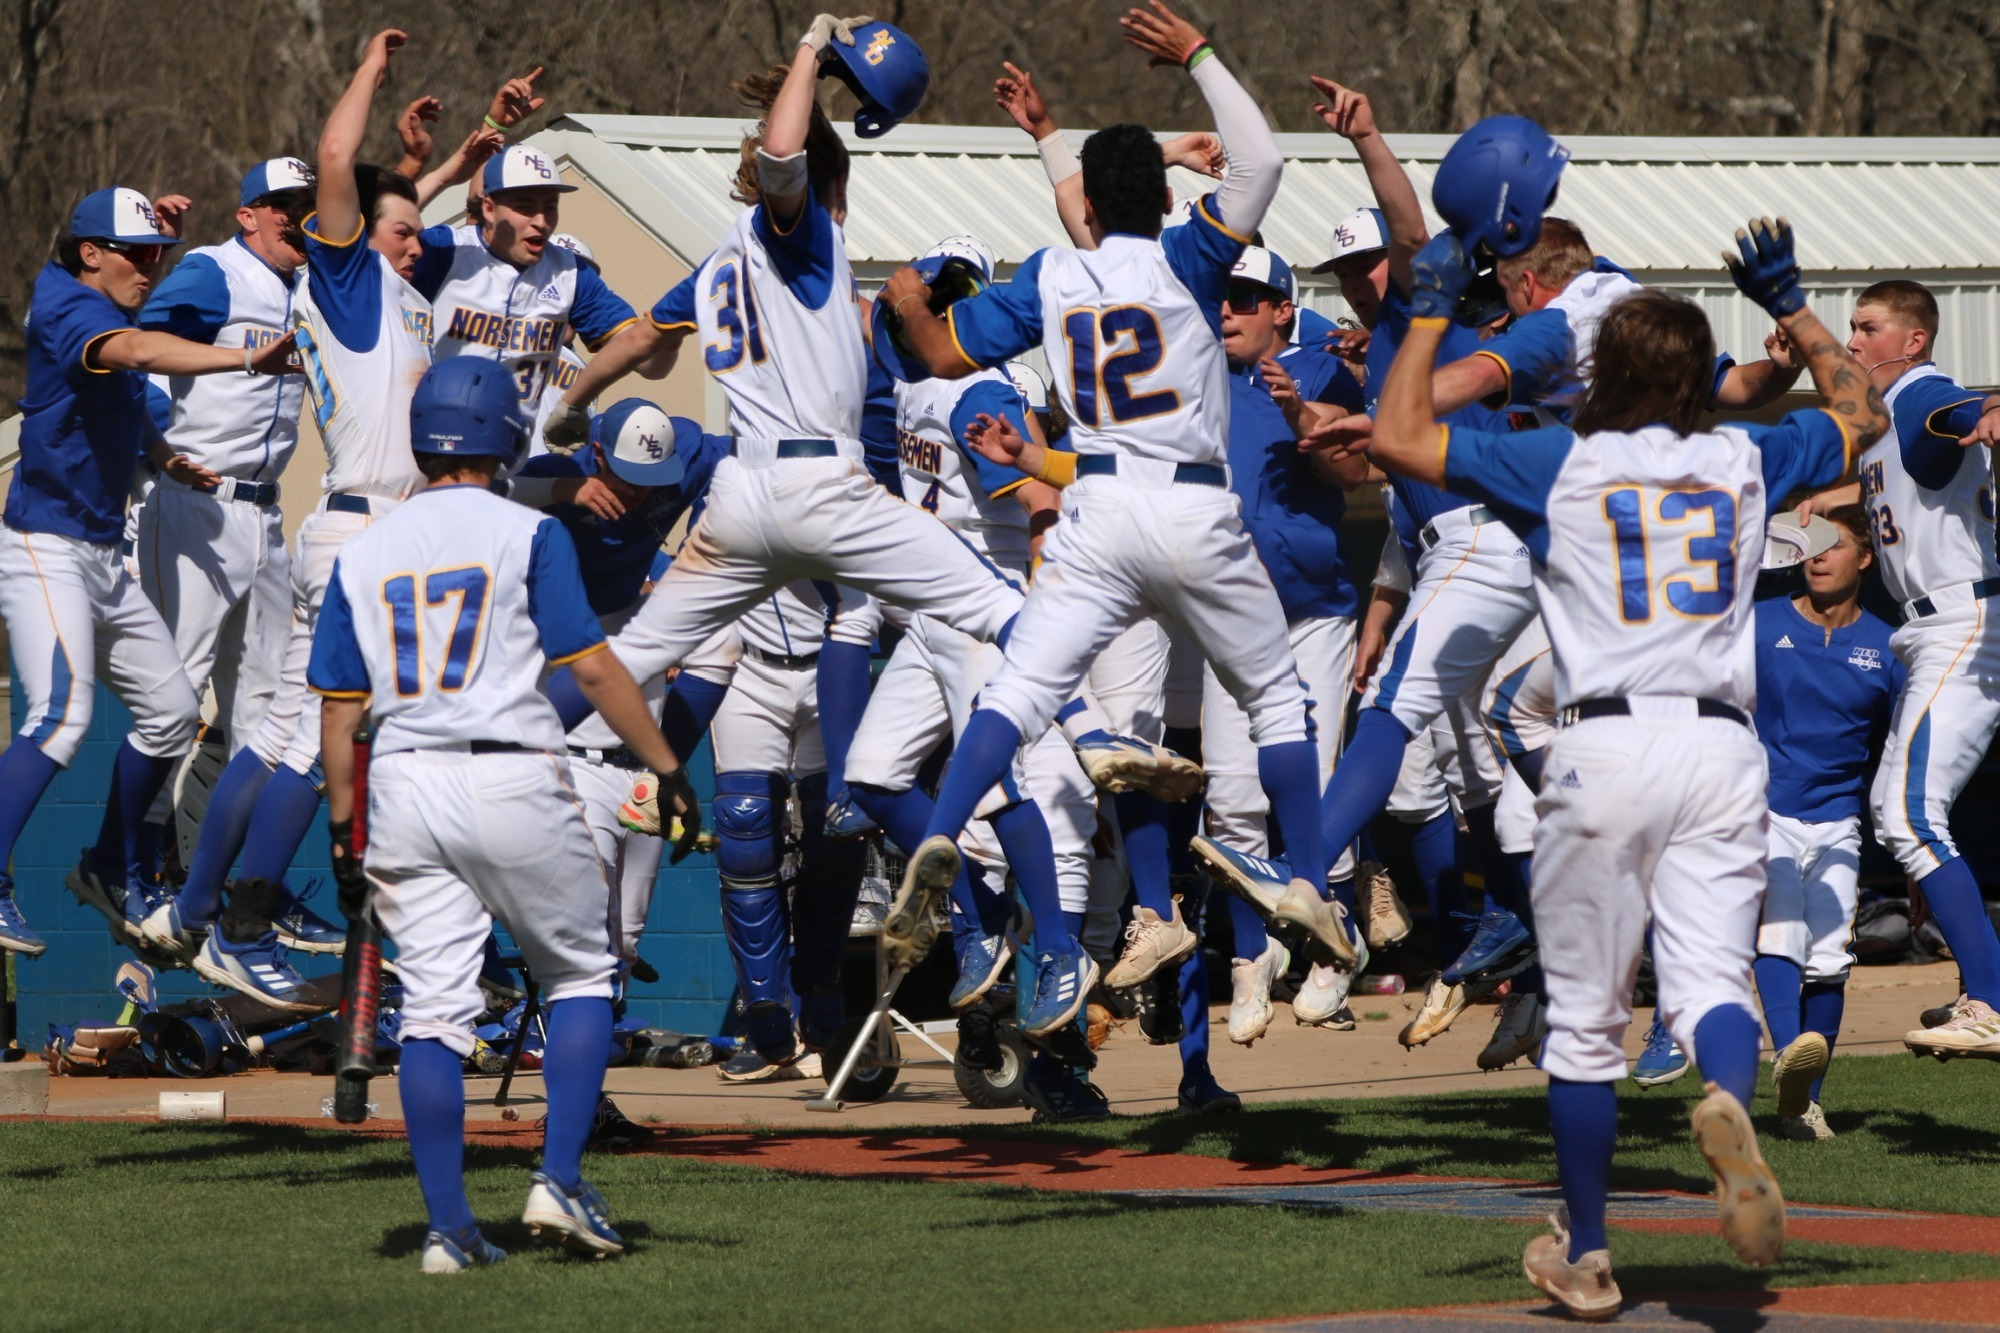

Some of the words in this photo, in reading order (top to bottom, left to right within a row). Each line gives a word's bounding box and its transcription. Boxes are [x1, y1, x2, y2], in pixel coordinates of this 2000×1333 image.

[865, 29, 896, 66] NEO
[525, 154, 552, 179] NEO
[1334, 225, 1356, 248] NEO
[448, 307, 567, 352] NORSEMEN
[705, 249, 769, 376] 31
[1062, 303, 1184, 428] 12
[638, 434, 664, 459] NEO
[1601, 483, 1740, 625] 13
[381, 563, 493, 699] 17
[1853, 646, 1880, 659] NEO
